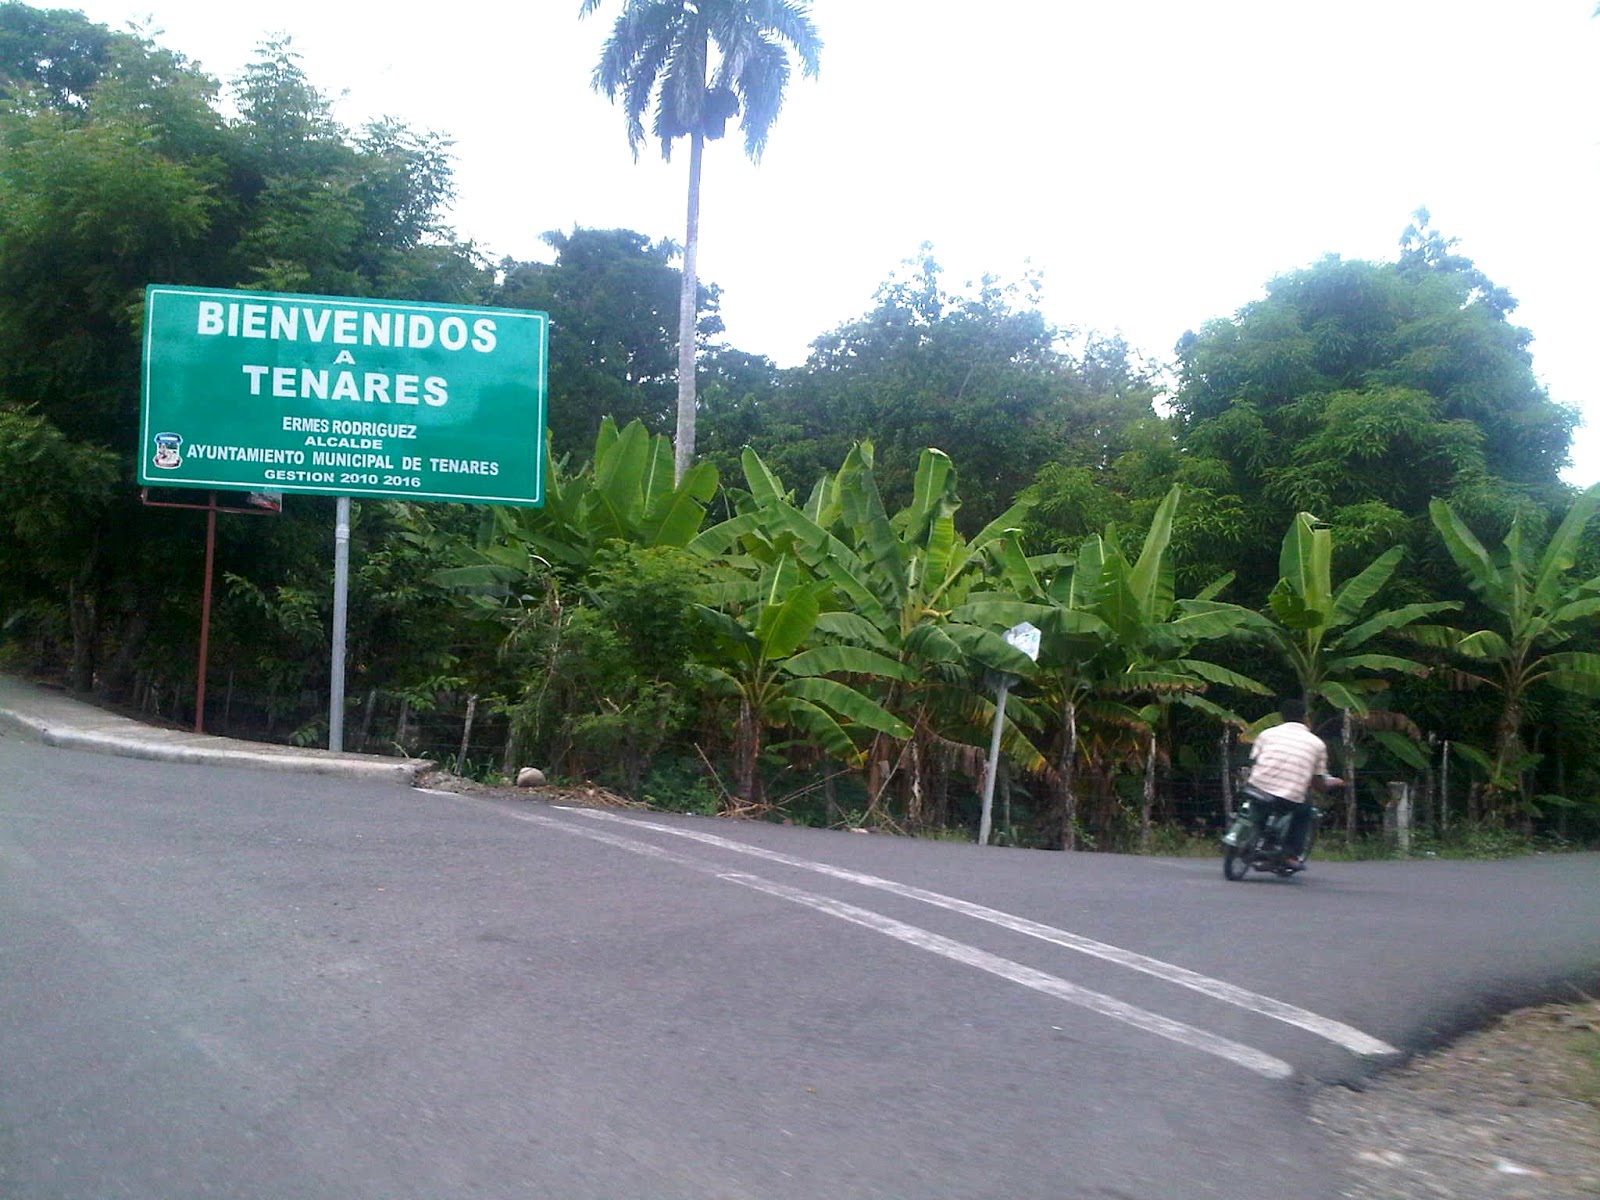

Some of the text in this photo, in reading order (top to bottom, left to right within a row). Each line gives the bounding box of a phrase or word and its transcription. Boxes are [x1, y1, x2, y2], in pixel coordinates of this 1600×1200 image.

[197, 302, 497, 353] BIENVENIDOS
[333, 350, 355, 364] A
[243, 365, 448, 407] TENARES
[283, 417, 417, 439] ERMES RODRIGUEZ
[304, 437, 383, 450] ALCALDE
[186, 444, 499, 475] AYUNTAMIENTO MUNICIPAL DE TENARES
[264, 469, 421, 487] GESTION 2010 2016
